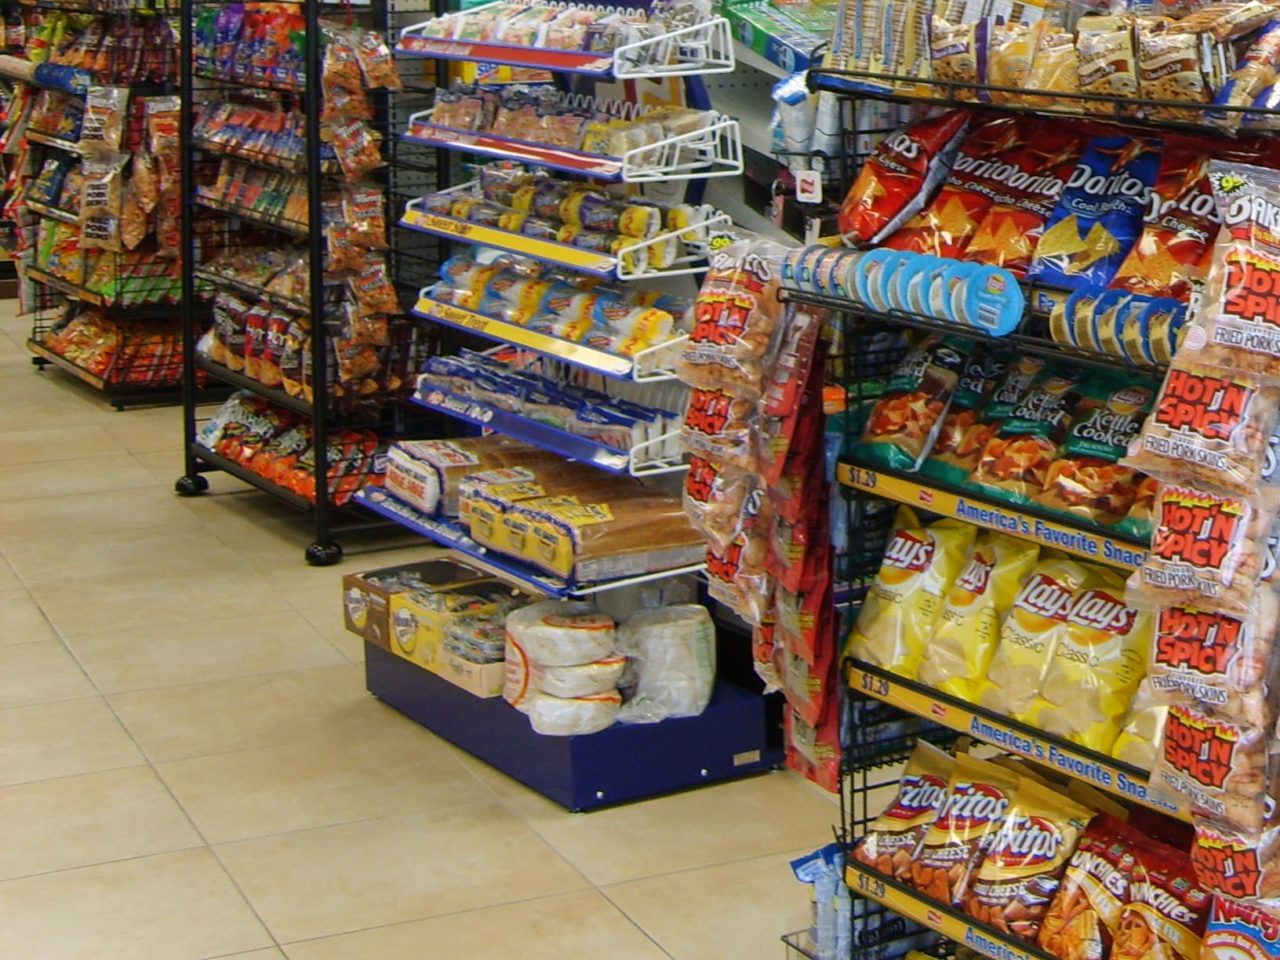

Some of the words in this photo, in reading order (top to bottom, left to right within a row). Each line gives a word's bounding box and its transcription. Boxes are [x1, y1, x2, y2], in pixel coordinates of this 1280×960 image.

[1066, 164, 1153, 205] Doritos
[1089, 407, 1140, 434] Kettle
[956, 498, 1030, 535] America's
[1035, 520, 1097, 554] Favorite
[970, 715, 1044, 758] America's
[1048, 746, 1111, 786] Favorite
[901, 782, 948, 810] ritos
[942, 787, 1008, 824] ritos
[1072, 849, 1129, 896] UNCHIES
